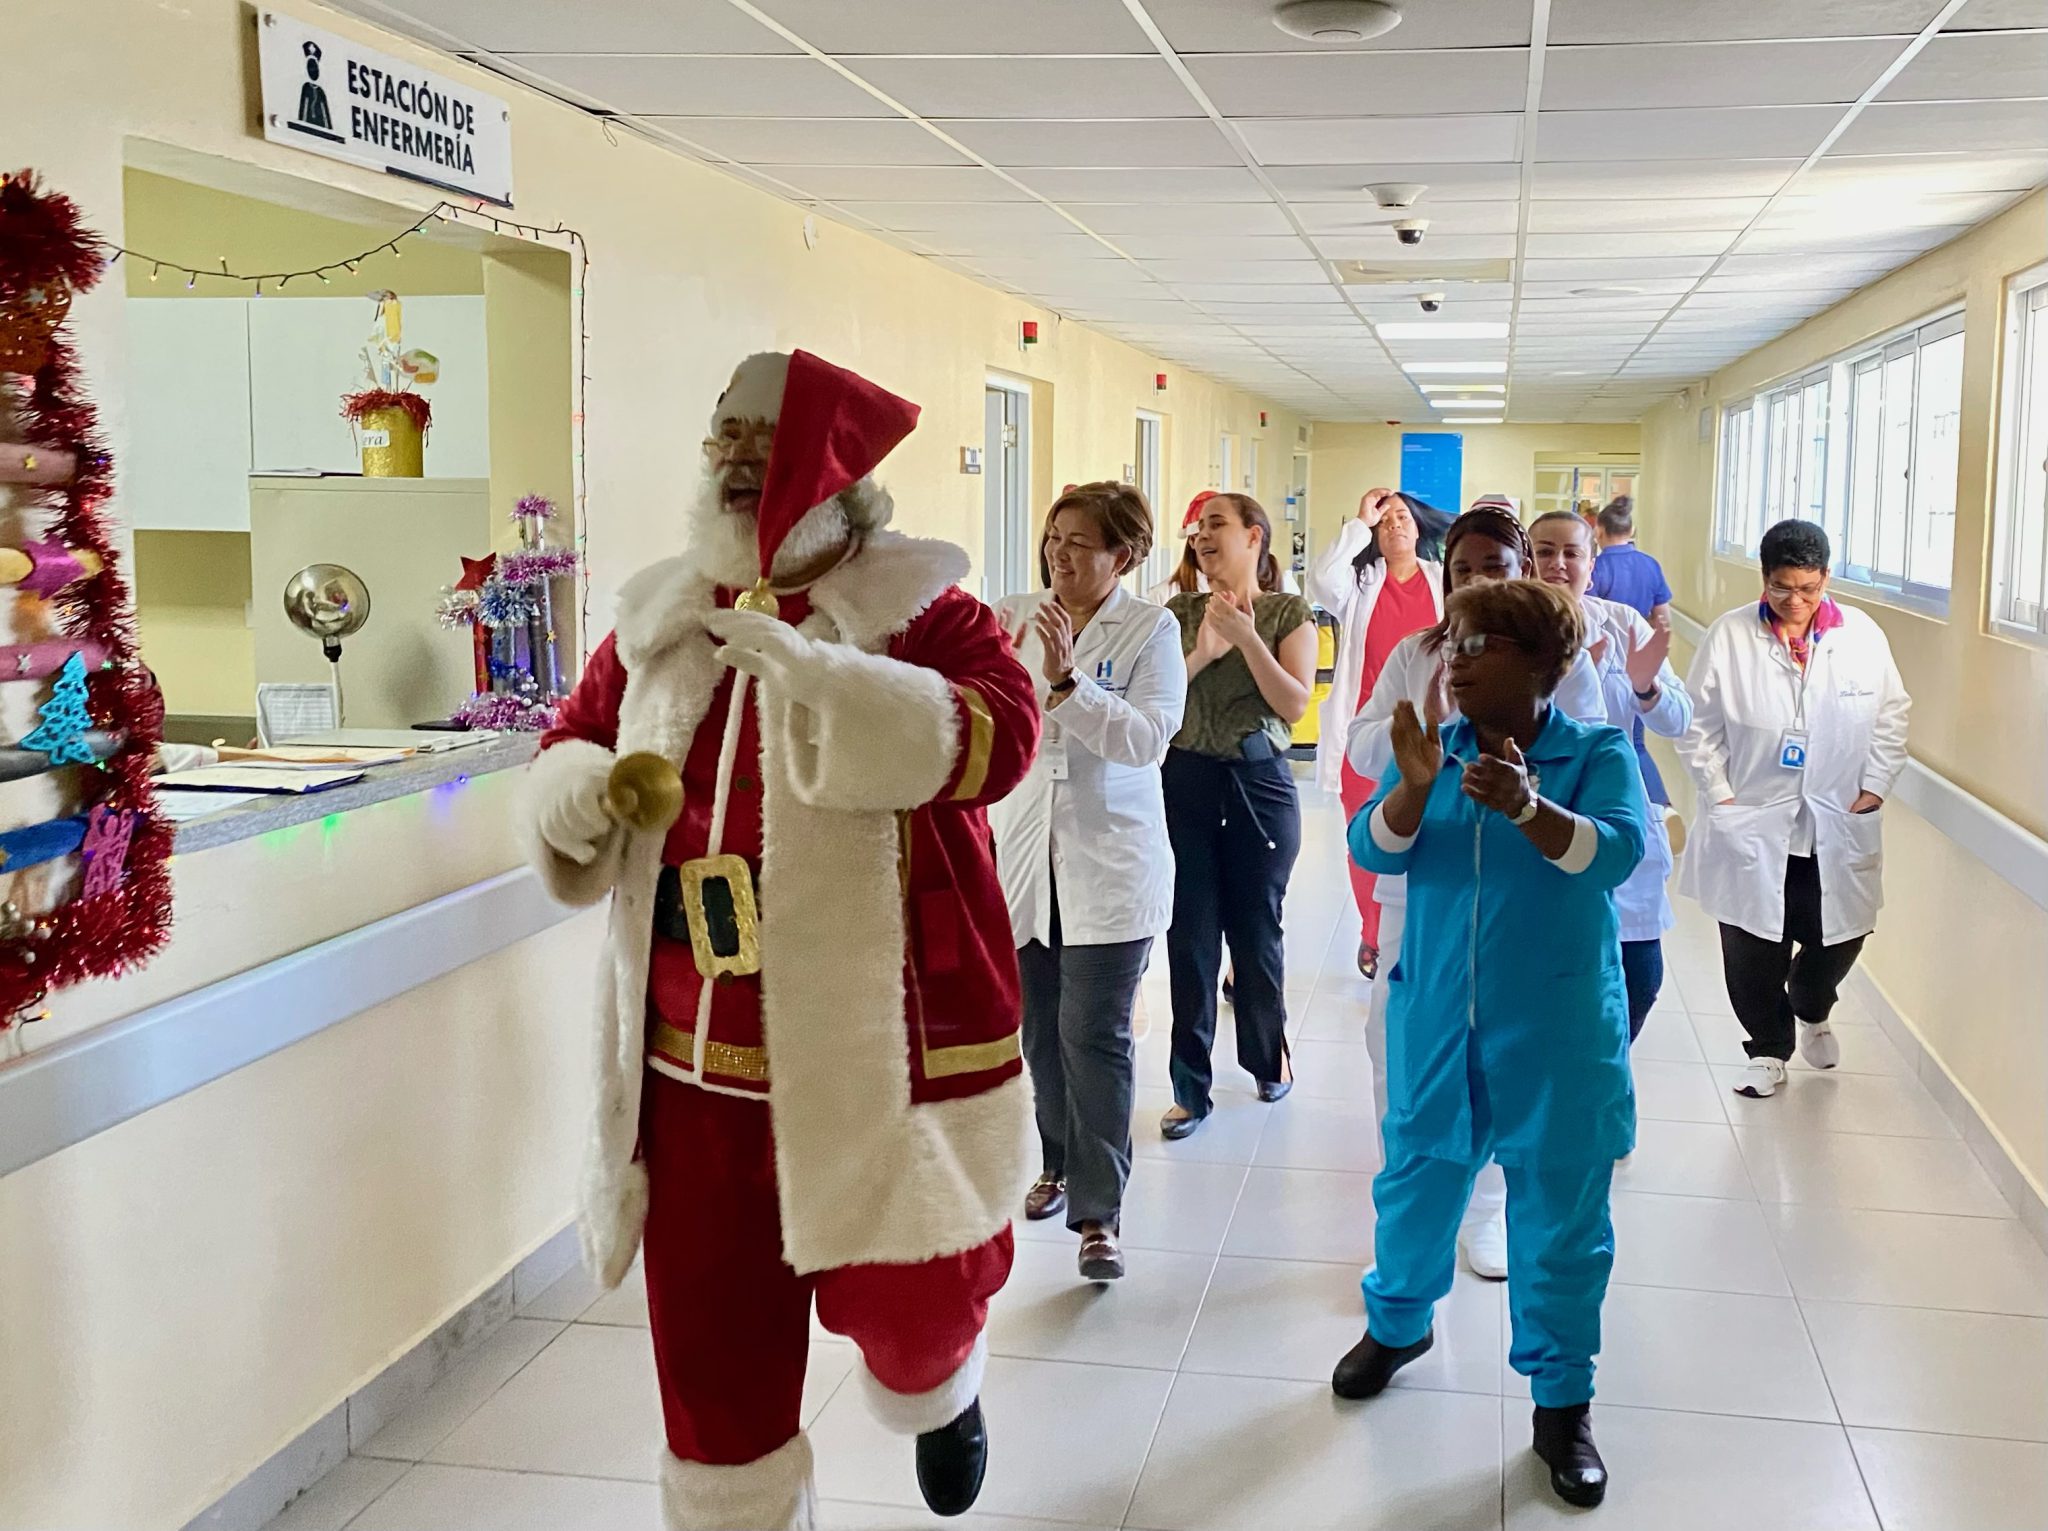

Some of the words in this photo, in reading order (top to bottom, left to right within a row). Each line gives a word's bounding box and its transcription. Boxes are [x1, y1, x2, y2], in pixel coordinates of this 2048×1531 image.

[347, 60, 448, 126] ESTACIÓN
[453, 98, 475, 135] DE
[351, 105, 475, 175] ENFERMERÍA
